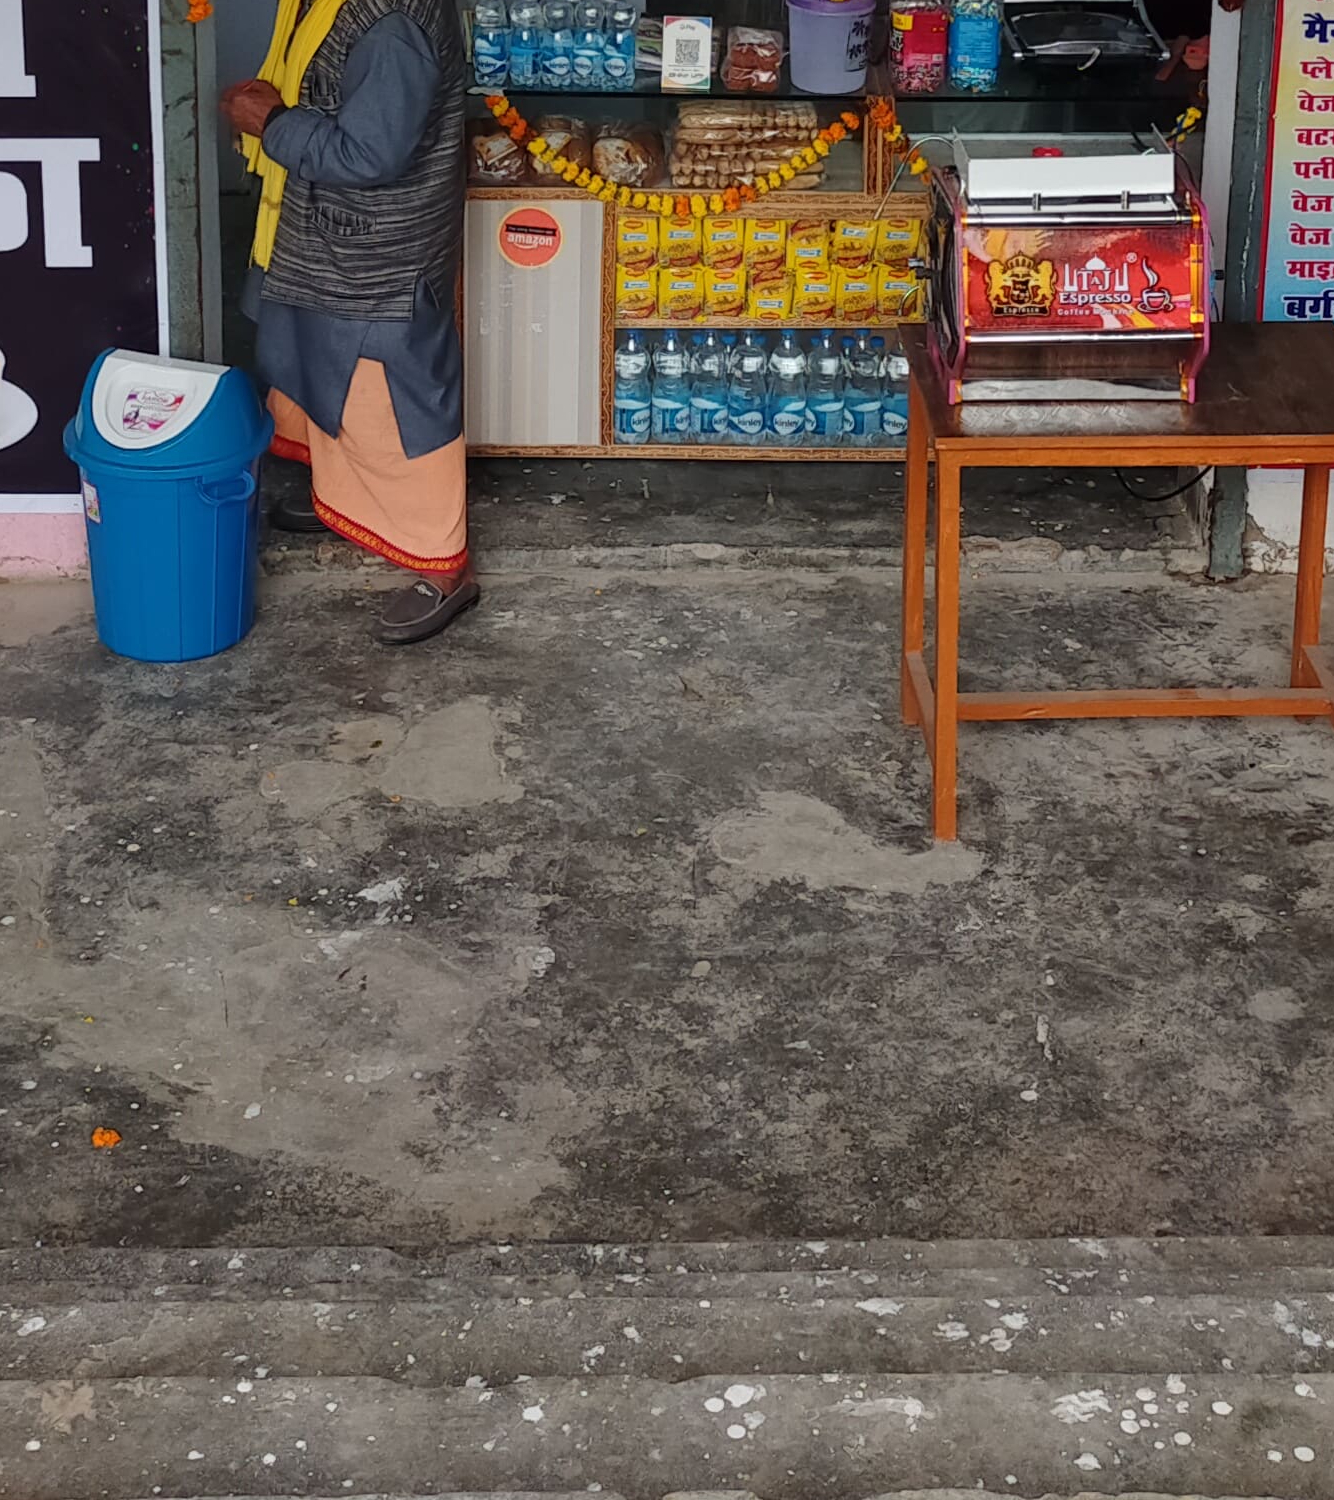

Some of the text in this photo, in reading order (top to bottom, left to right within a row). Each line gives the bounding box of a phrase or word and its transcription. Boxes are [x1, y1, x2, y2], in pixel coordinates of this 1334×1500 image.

[1293, 191, 1333, 213] वेज
[507, 233, 553, 246] amazon
[1291, 224, 1331, 245] वेज
[1059, 292, 1132, 305] Espresso
